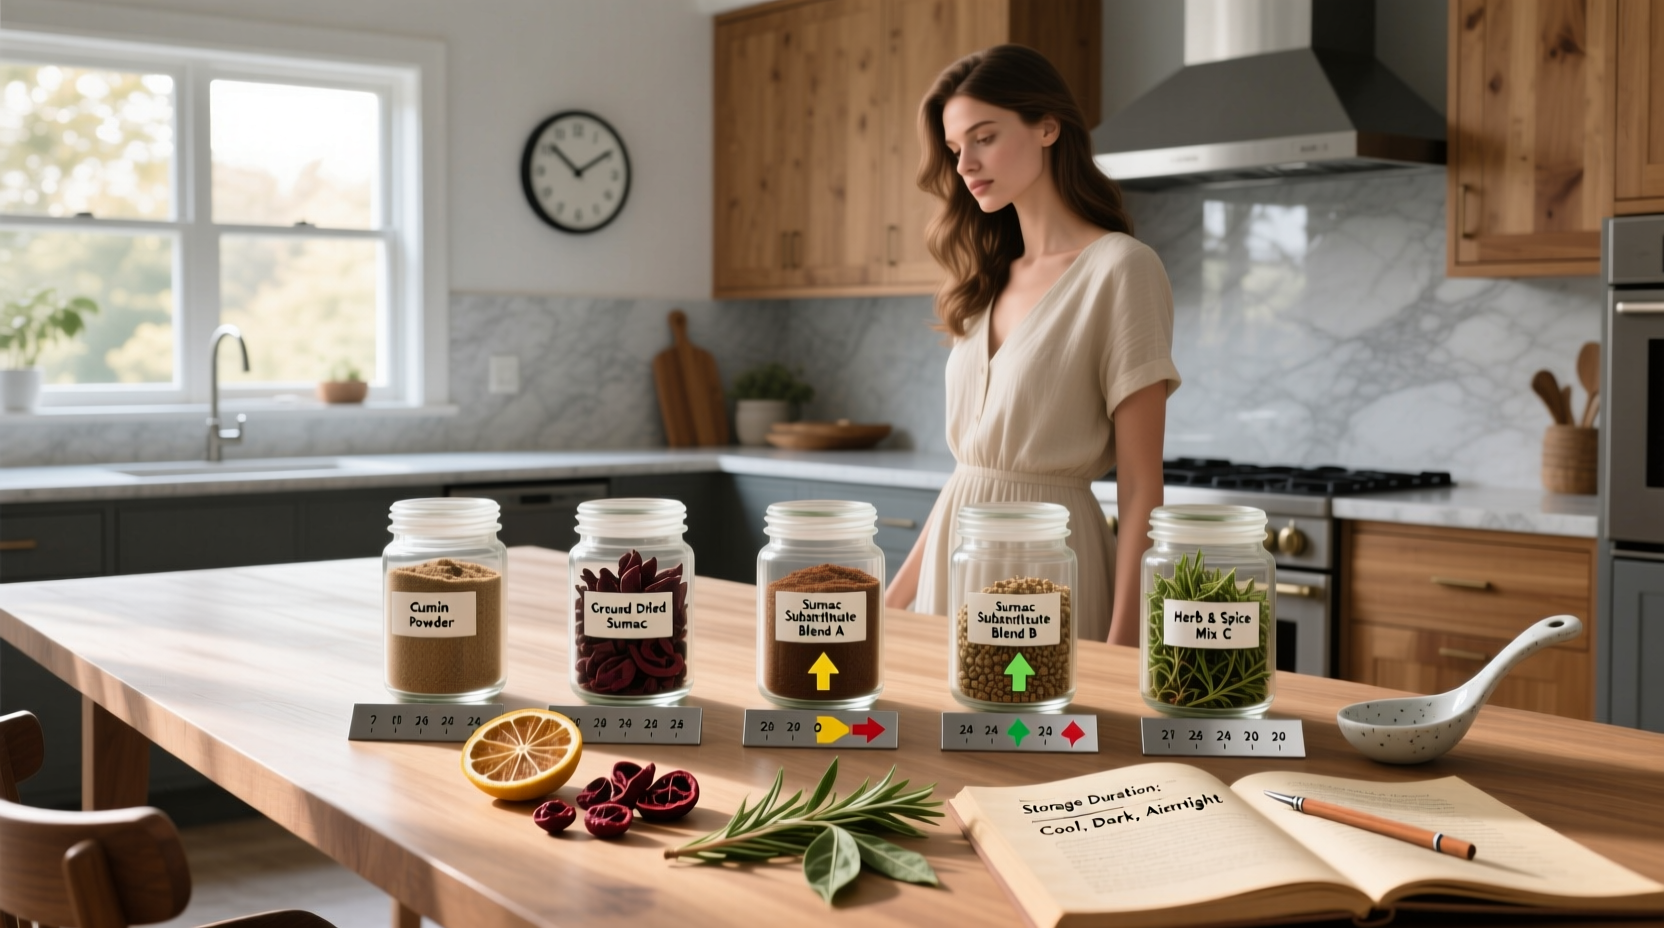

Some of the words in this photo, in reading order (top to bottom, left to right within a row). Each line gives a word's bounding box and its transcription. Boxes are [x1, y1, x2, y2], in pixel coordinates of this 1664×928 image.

[410, 601, 450, 614] Cumin
[802, 599, 842, 610] Sumac
[996, 601, 1035, 612] Sumac
[409, 616, 455, 628] Powder
[606, 617, 648, 629] Sumac
[1174, 611, 1203, 623] Herb
[1208, 612, 1216, 623] &
[1221, 612, 1251, 625] Spice
[799, 625, 831, 636] Blend
[836, 625, 844, 636] A
[992, 627, 1024, 639] Blend
[1196, 628, 1217, 639] Mix
[1223, 628, 1231, 639] C
[1244, 731, 1259, 742] 20
[1272, 732, 1286, 742] 20
[1088, 784, 1161, 805] Duration:
[1040, 821, 1088, 835] Cool,
[1092, 811, 1140, 828] Dark,
